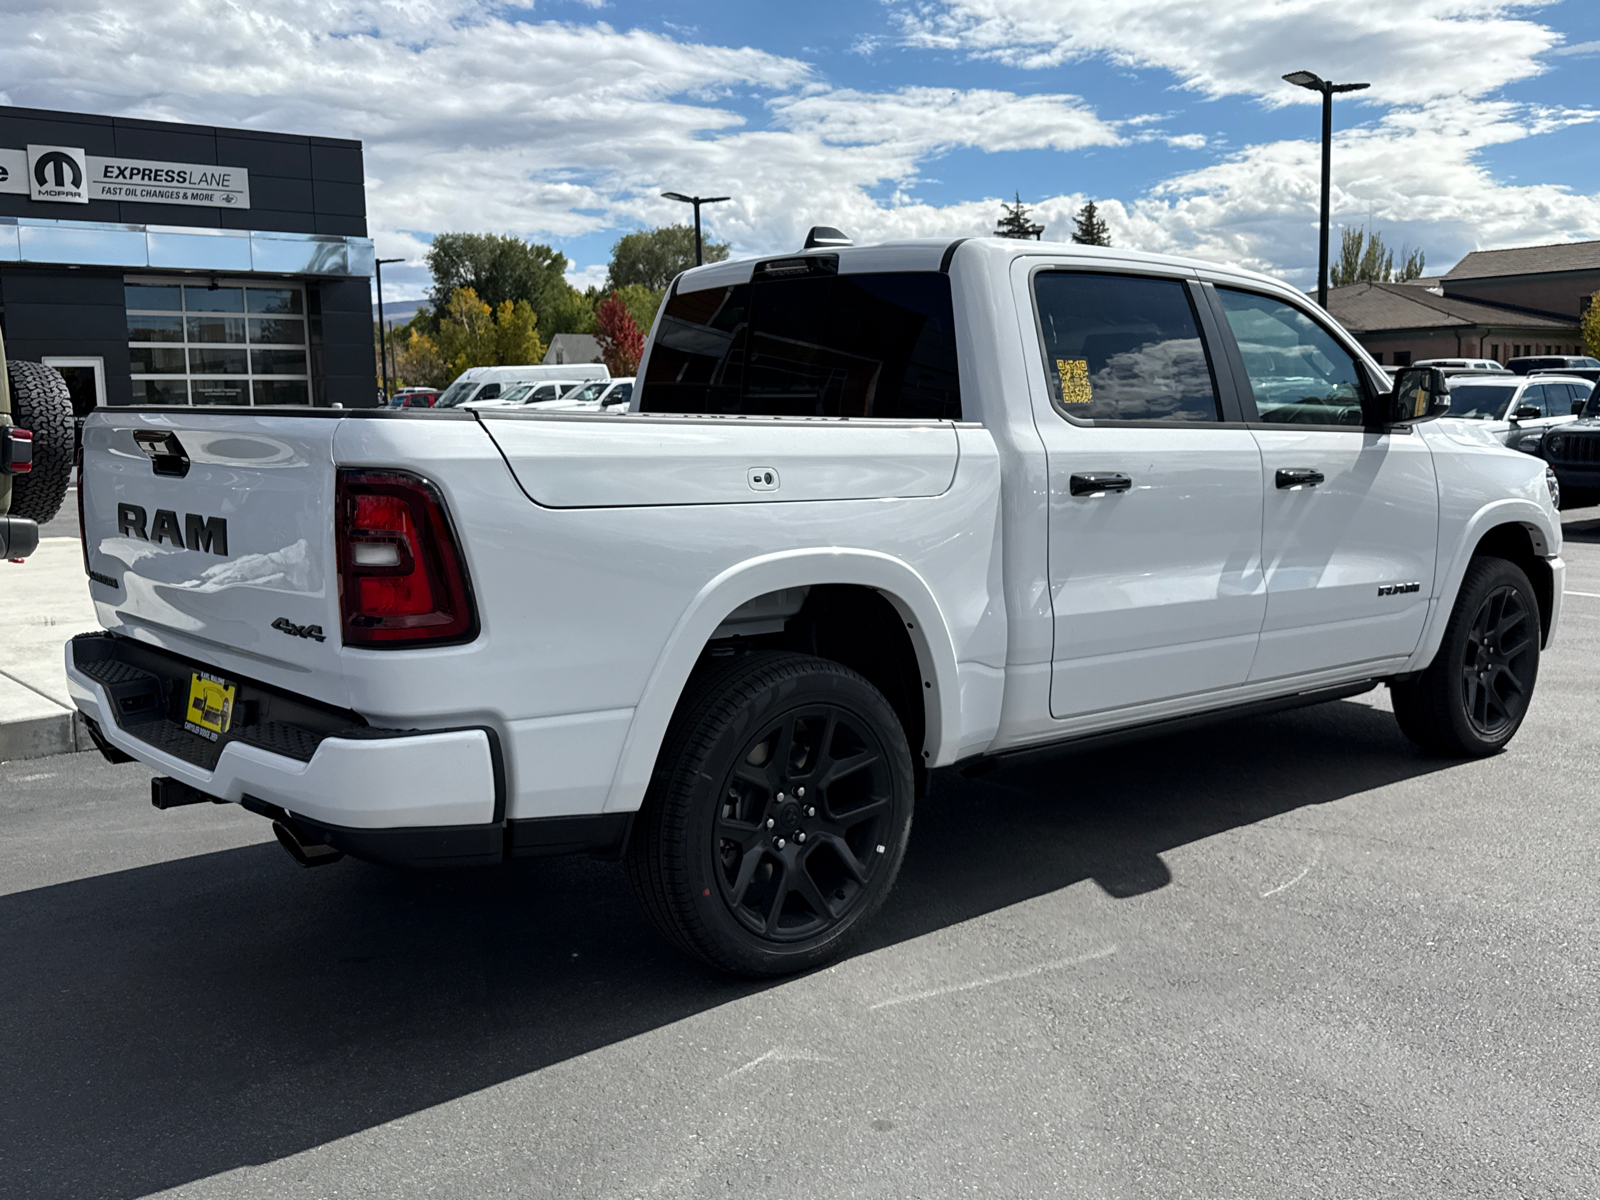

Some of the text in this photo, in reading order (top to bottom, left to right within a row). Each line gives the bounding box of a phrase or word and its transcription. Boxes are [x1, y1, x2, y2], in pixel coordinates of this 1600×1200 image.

[38, 190, 83, 199] MOPAR
[101, 186, 214, 202] FAST OIL CHANGES & MORE
[117, 502, 228, 556] RAM
[1378, 582, 1420, 597] RAM
